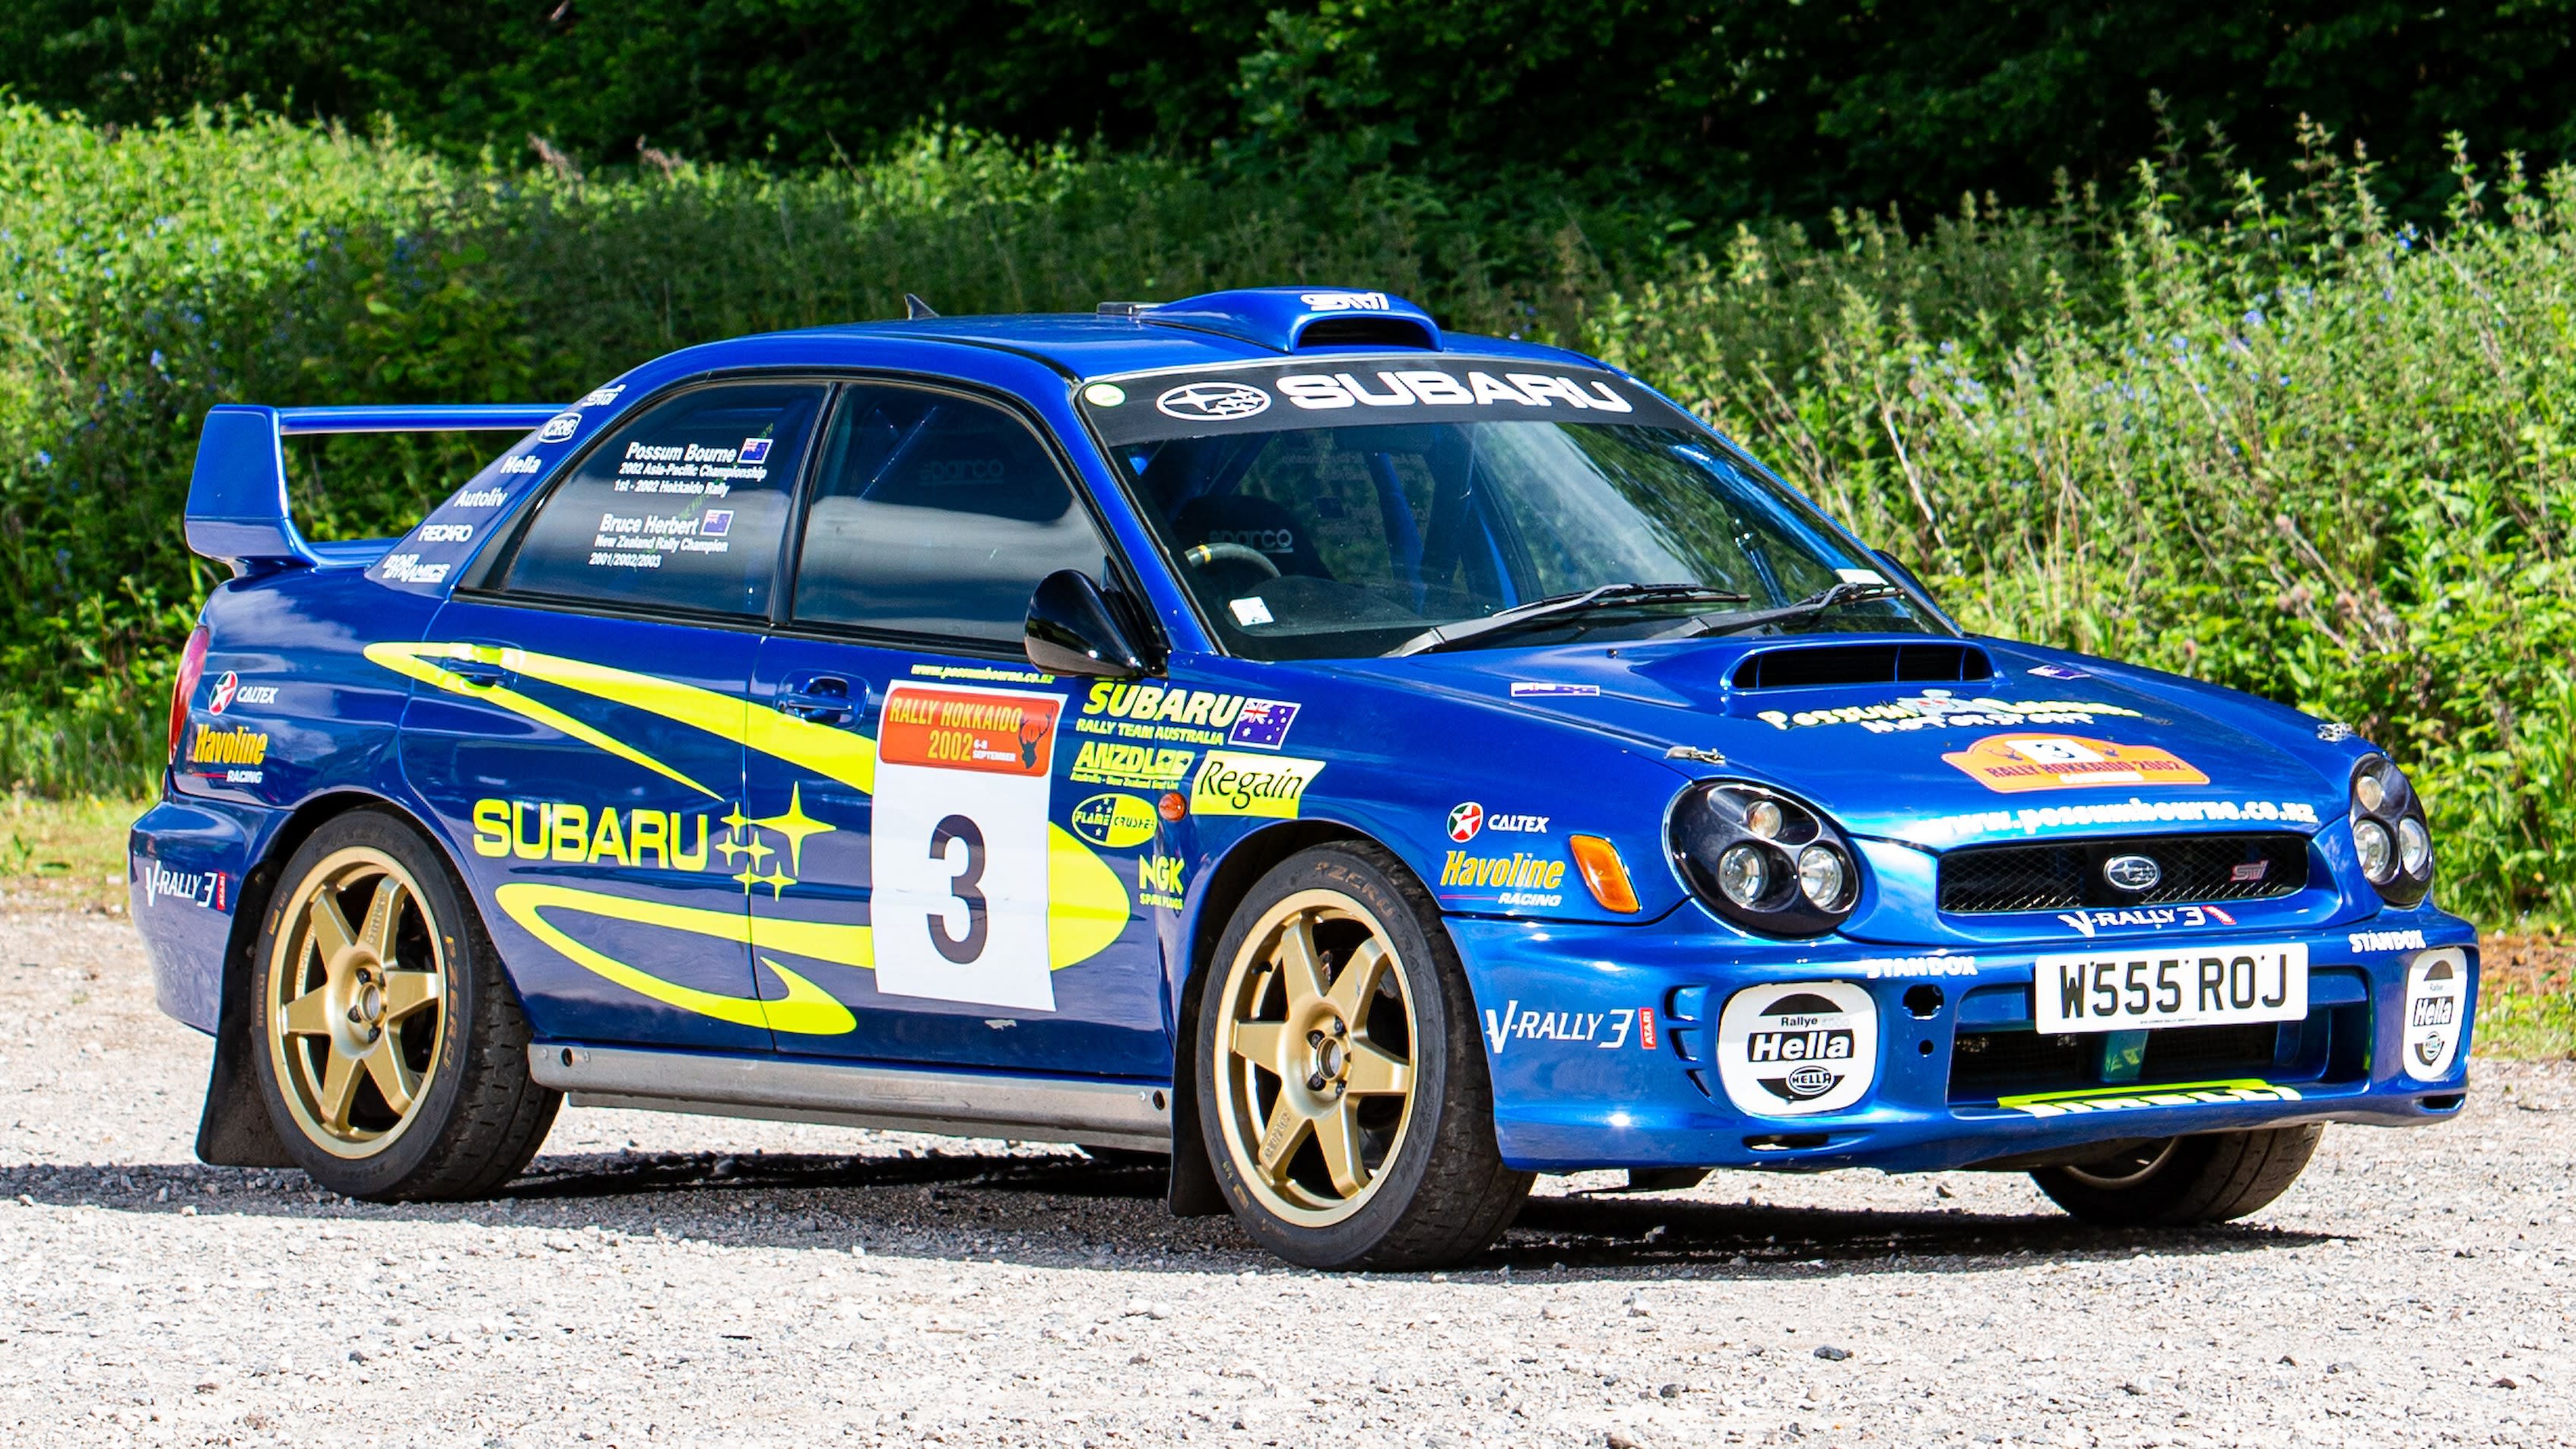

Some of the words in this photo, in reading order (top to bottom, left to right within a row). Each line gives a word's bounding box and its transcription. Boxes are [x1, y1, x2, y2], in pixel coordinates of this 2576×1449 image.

[1276, 370, 1633, 413] SUBARU
[625, 441, 684, 461] Possum
[684, 443, 737, 463] Bourne
[500, 455, 541, 474] Hella
[619, 462, 642, 474] 2002
[642, 463, 698, 477] Asia-Pacific
[699, 465, 767, 482] Championship
[454, 487, 508, 507] Autoliv
[614, 480, 630, 492] 1st
[634, 480, 658, 493] 2002
[658, 480, 705, 495] Hokkaido
[704, 481, 730, 498] Rally
[418, 525, 473, 542] RECARO
[599, 513, 642, 533] Bruce
[643, 515, 700, 536] Herbert
[594, 534, 617, 548] New
[617, 535, 655, 550] Zealand
[655, 537, 680, 553] Rally
[680, 539, 729, 554] Champion
[588, 552, 661, 568] 2001/2002/2003
[236, 686, 279, 704] CALTEX
[1082, 682, 1245, 728] SUBARU
[889, 697, 939, 726] RALLY
[940, 702, 1023, 733] HOKKAIDO
[1075, 718, 1116, 735] RALLY
[1118, 722, 1153, 740] TEAM
[1154, 726, 1225, 746] AUSTRALIA
[193, 724, 268, 766] Havoline
[927, 730, 973, 761] 2002
[2035, 744, 2076, 759] 3
[226, 770, 263, 784] RACING
[1984, 766, 2038, 778] RALLY
[2133, 760, 2187, 771] 2002
[1199, 761, 1302, 809] Regain
[1074, 810, 1111, 826] FLAME
[1488, 814, 1550, 834] CALTEX
[472, 799, 709, 872] SUBARU
[1139, 854, 1185, 895] NGK
[1439, 851, 1566, 889] Havoline
[145, 860, 201, 907] V-RALLY
[197, 872, 217, 908] 3
[927, 814, 988, 965] 3
[1498, 893, 1562, 907] RACING
[2057, 910, 2176, 938] V-RALLY
[2177, 906, 2206, 926] 3
[2349, 930, 2426, 953] STANDOX
[1865, 956, 1978, 979] STANDOX
[2060, 960, 2184, 1019] W555
[2200, 953, 2287, 1012] ROJ
[1781, 1016, 1818, 1028] Rallye
[2415, 997, 2453, 1026] Hella
[1486, 1000, 1604, 1054] V-RALLY
[1597, 1009, 1635, 1048] 3
[1644, 1010, 1654, 1045] ATARI
[1752, 1032, 1850, 1061] Hella
[1792, 1073, 1832, 1084] HELLA
